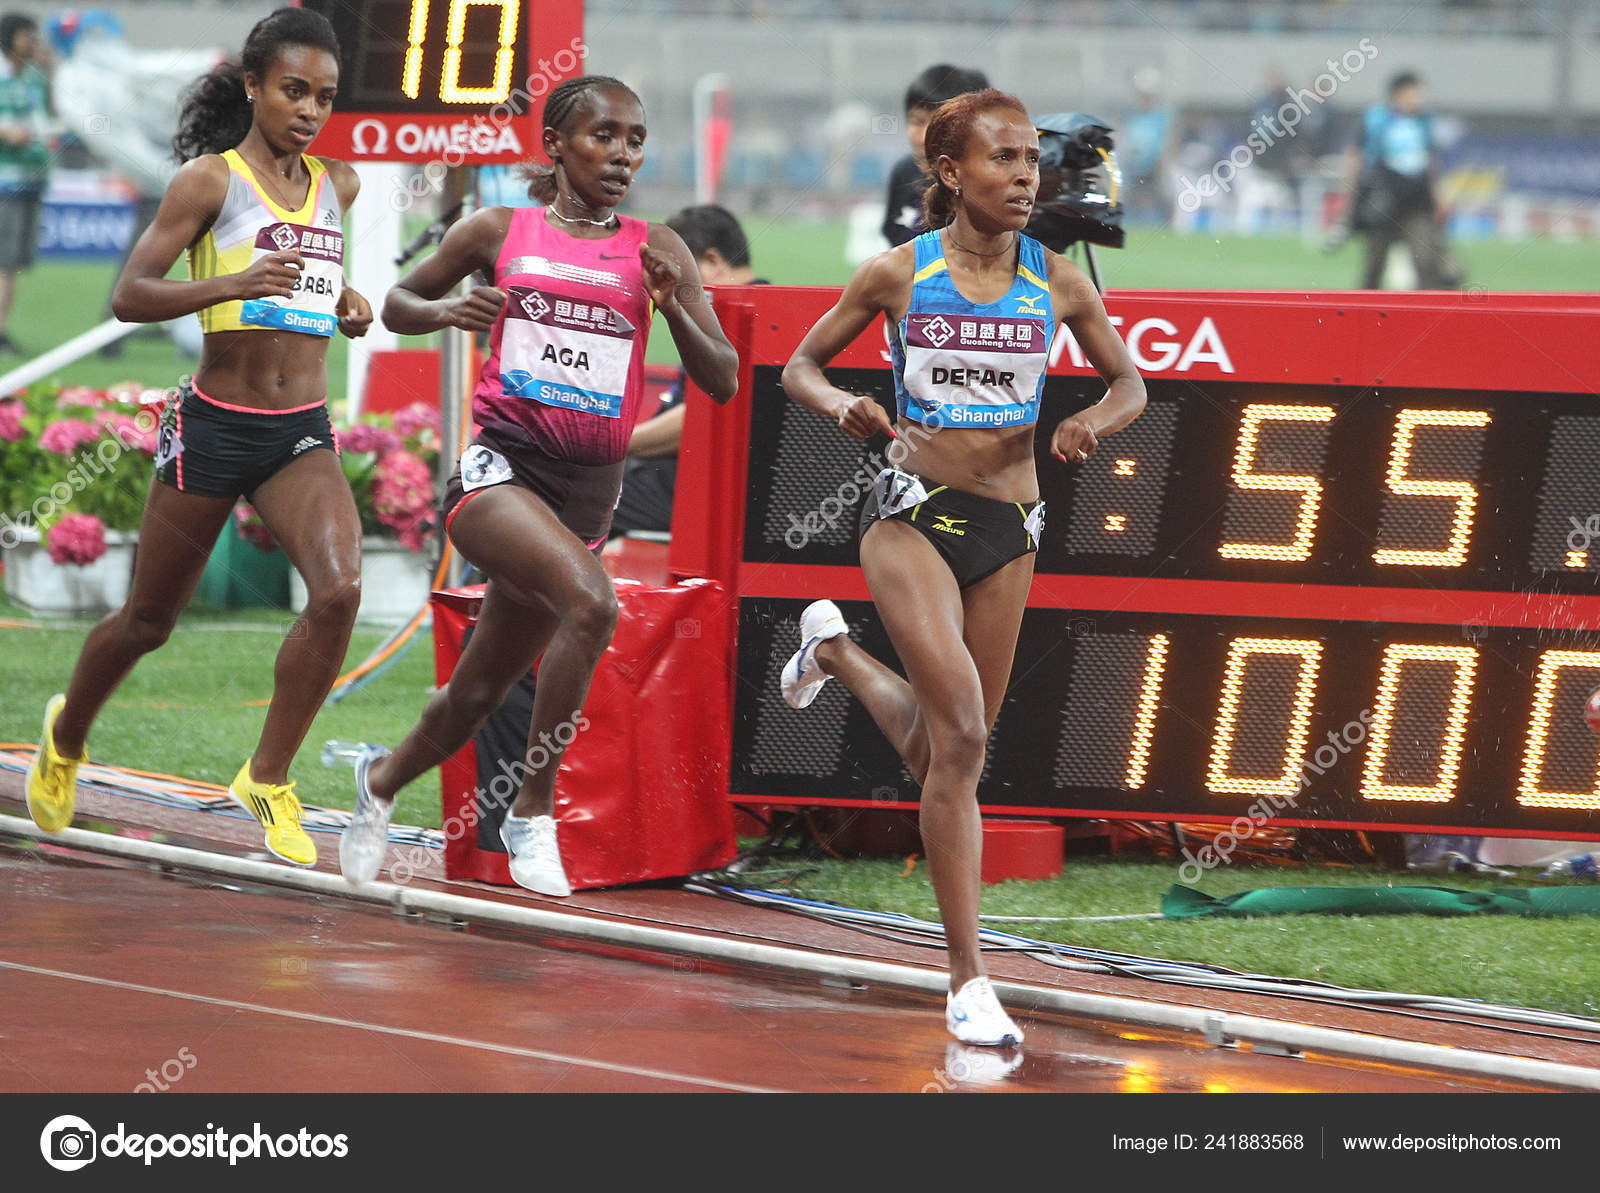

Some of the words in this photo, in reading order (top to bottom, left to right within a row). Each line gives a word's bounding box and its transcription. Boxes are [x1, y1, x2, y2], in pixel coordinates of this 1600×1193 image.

[401, 0, 521, 104] 10
[395, 123, 522, 155] OMEGA
[291, 276, 334, 297] BABA
[284, 312, 333, 332] Shangh
[554, 315, 595, 329] Guosheng
[598, 322, 617, 332] Grou
[960, 321, 1032, 341] 国盛集团
[960, 338, 1003, 348] Guosheng
[1007, 340, 1031, 349] Group
[541, 343, 590, 371] AGA
[931, 367, 1015, 388] DEFAR
[465, 449, 493, 483] 3
[883, 471, 916, 507] 17
